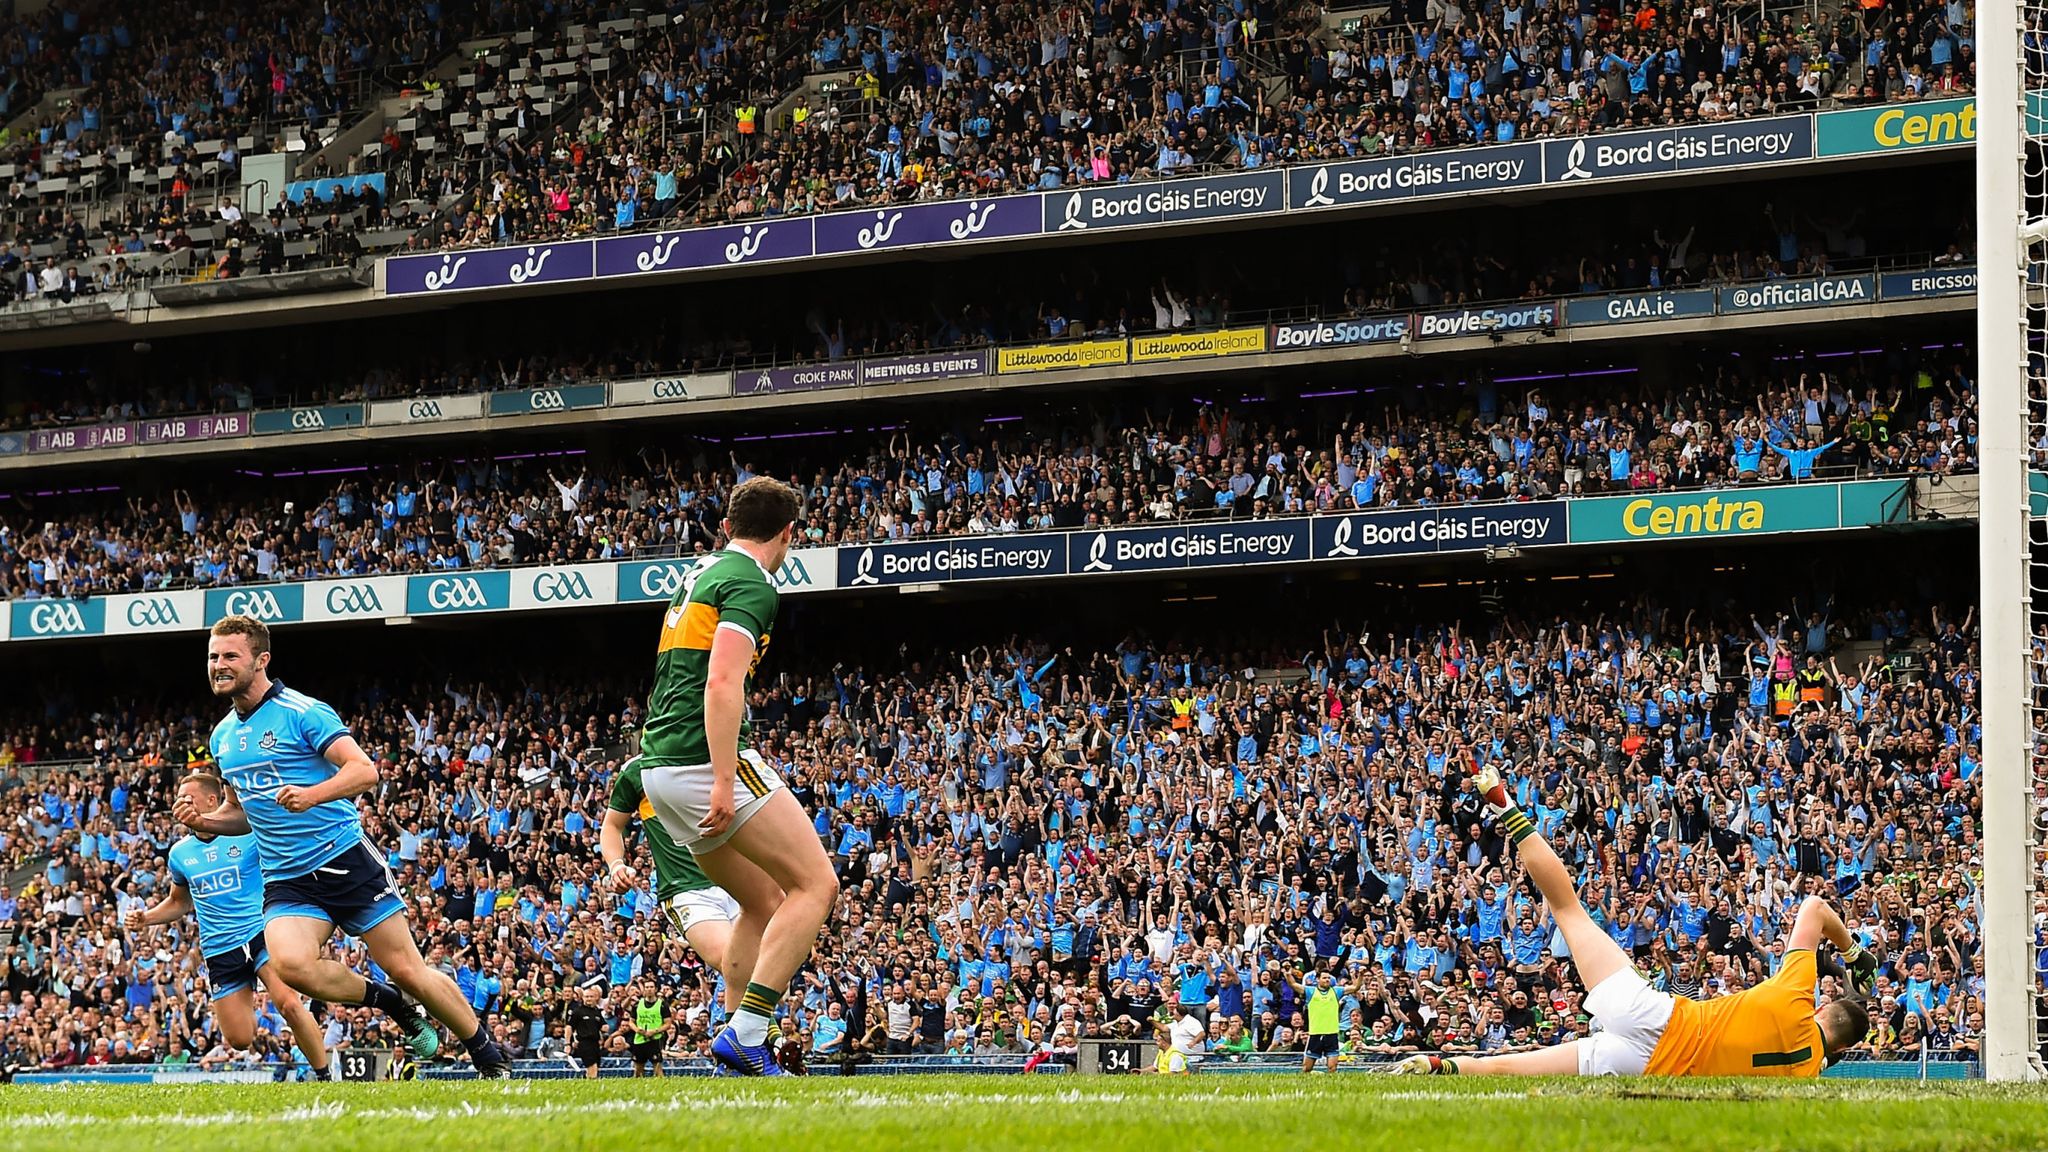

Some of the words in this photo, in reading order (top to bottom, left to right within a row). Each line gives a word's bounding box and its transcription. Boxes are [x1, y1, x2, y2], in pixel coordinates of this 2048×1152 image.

[1597, 139, 1652, 167] Bord
[1657, 135, 1707, 162] Gáis
[1711, 130, 1794, 157] Energy
[1339, 168, 1392, 194] Bord
[1396, 163, 1443, 187] Gáis
[1446, 158, 1525, 183] Energy
[1091, 192, 1142, 219] Bord
[1145, 187, 1190, 214] Gáis
[1193, 186, 1268, 209] Energy
[857, 210, 902, 248] eir
[950, 200, 996, 239] eir
[636, 234, 680, 271] eir
[724, 225, 769, 263] eir
[424, 254, 466, 290] eir
[509, 246, 552, 283] eir
[1733, 279, 1864, 308] @officialGAA
[1420, 305, 1553, 336] BoyleSports
[1607, 299, 1675, 319] GAA.ie
[1276, 319, 1404, 346] BoyleSports
[793, 370, 827, 384] CROKE
[829, 368, 854, 382] PARK
[865, 363, 922, 379] MEETINGS
[922, 362, 931, 374] &
[933, 359, 978, 373] EVENTS
[530, 390, 566, 410] GAA
[653, 379, 688, 398] GAA
[292, 411, 325, 430] GAA
[409, 400, 442, 418] GAA
[51, 432, 76, 448] AIB
[102, 427, 126, 444] AIB
[161, 422, 187, 439] AIB
[213, 418, 240, 434] AIB
[1363, 521, 1416, 545] Bord
[1419, 517, 1467, 541] Gáis
[1472, 515, 1551, 538] Energy
[1622, 498, 1765, 535] Centra
[883, 550, 931, 574] Bord
[934, 547, 978, 570] Gáis
[981, 547, 1053, 569] Energy
[1117, 536, 1168, 561] Bord
[1171, 533, 1216, 557] Gáis
[1220, 533, 1295, 556] Energy
[326, 584, 383, 614] GAA
[427, 577, 488, 609] GAA
[532, 571, 593, 602] GAA
[30, 602, 86, 633] GAA
[127, 597, 181, 627] GAA
[239, 736, 247, 752] 5
[206, 851, 218, 863] 15
[201, 872, 234, 893] AIG
[345, 1056, 366, 1077] 33
[1106, 1049, 1130, 1070] 34
